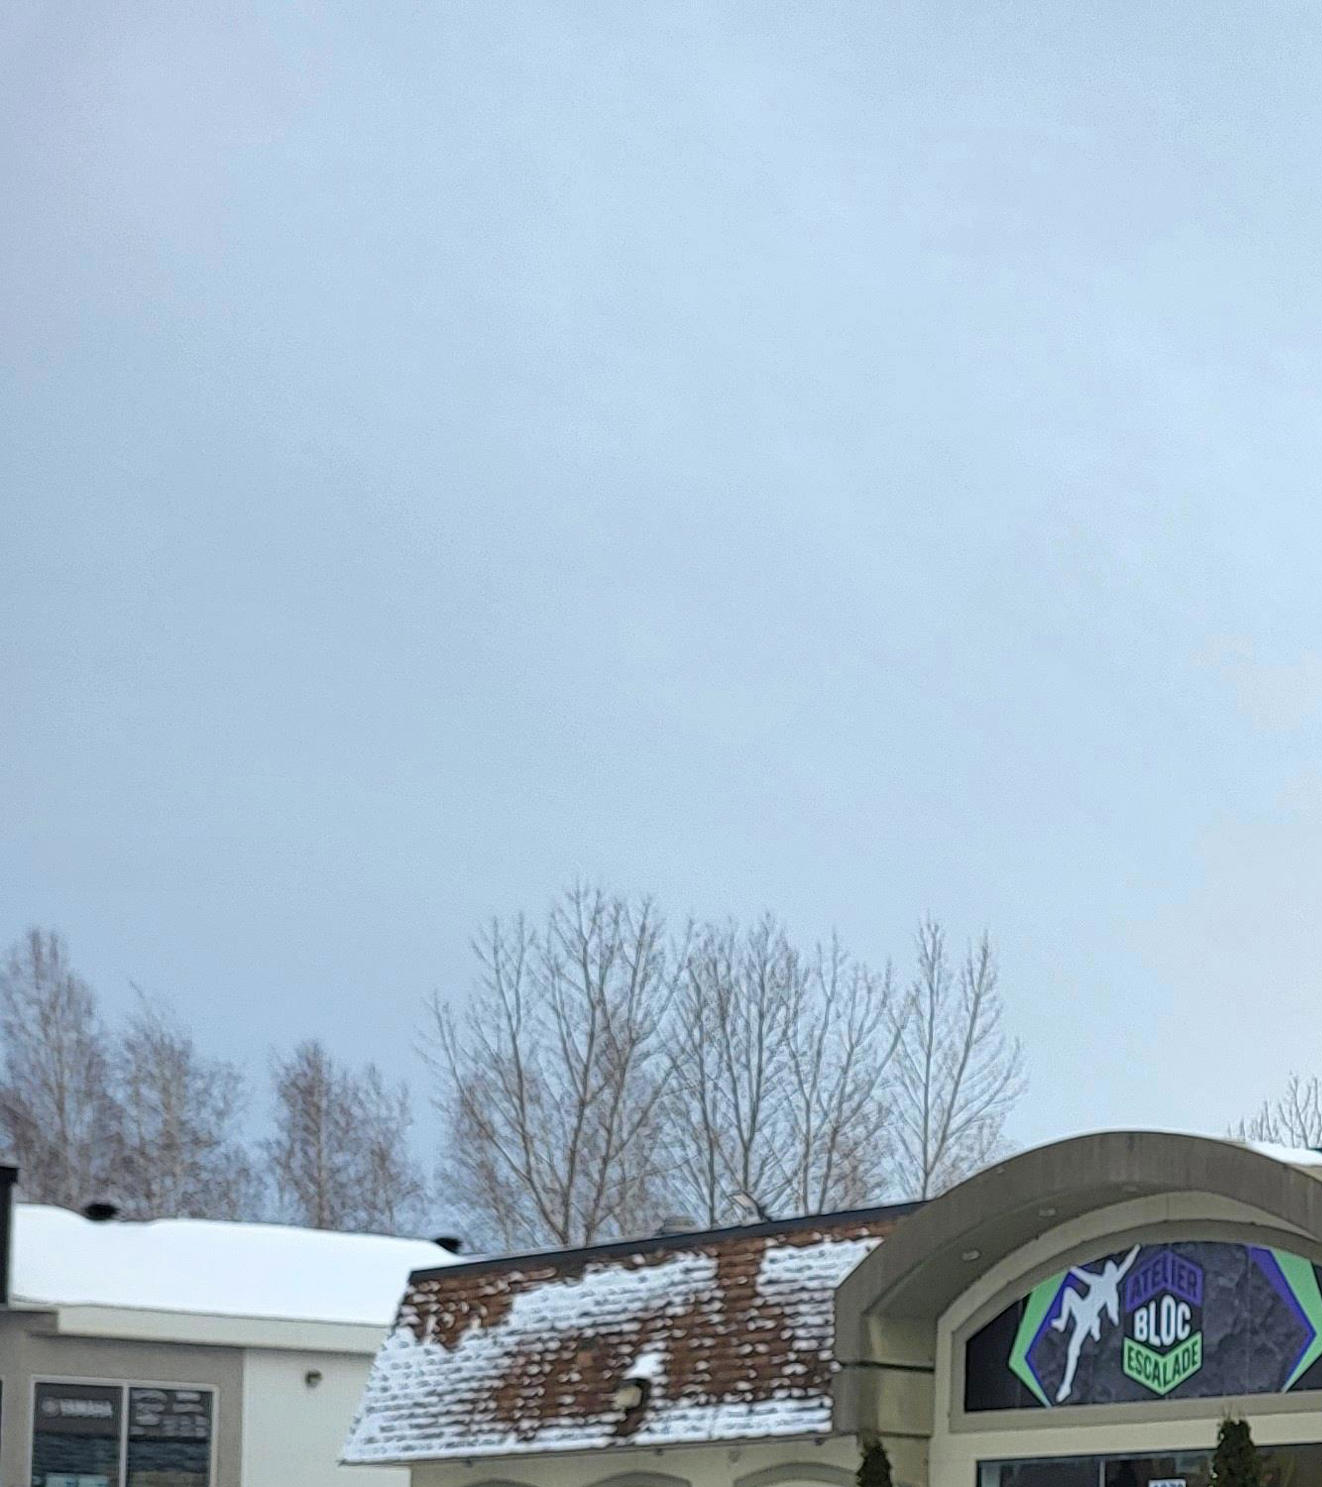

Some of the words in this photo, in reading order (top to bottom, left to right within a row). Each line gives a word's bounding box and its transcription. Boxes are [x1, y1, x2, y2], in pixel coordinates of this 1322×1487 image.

[1129, 1256, 1199, 1303] ATELIER
[1133, 1294, 1191, 1346] BLOC
[1127, 1340, 1199, 1387] ESCALADE
